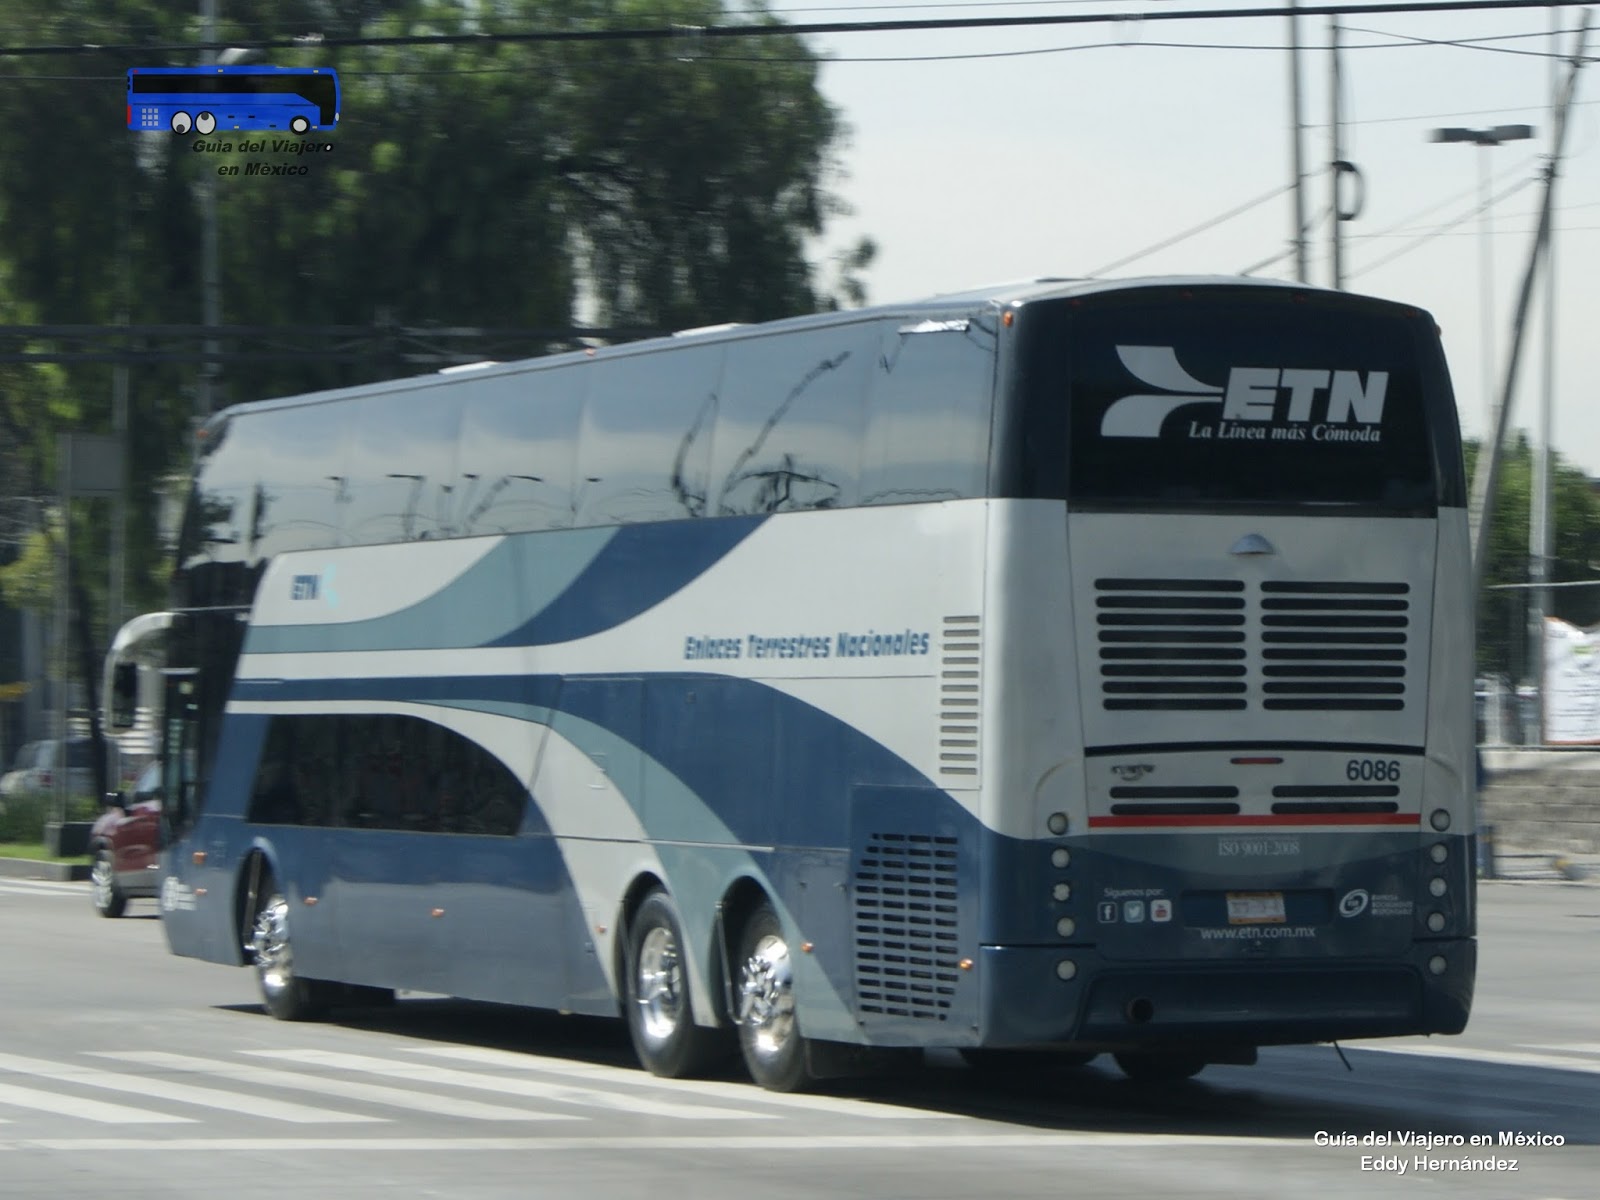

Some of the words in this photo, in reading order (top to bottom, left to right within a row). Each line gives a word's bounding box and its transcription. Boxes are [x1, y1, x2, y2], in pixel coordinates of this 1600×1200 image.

[1222, 366, 1390, 424] ETN
[1188, 420, 1212, 438] La
[1271, 422, 1307, 440] más
[1312, 423, 1382, 442] Cómoda
[683, 635, 742, 660] Enlaces
[747, 633, 832, 658] Terrestres
[836, 628, 930, 657] Nacionales
[1345, 760, 1401, 782] 6086
[1217, 840, 1239, 857] ISO
[1200, 926, 1316, 940] www.etn.com.mx
